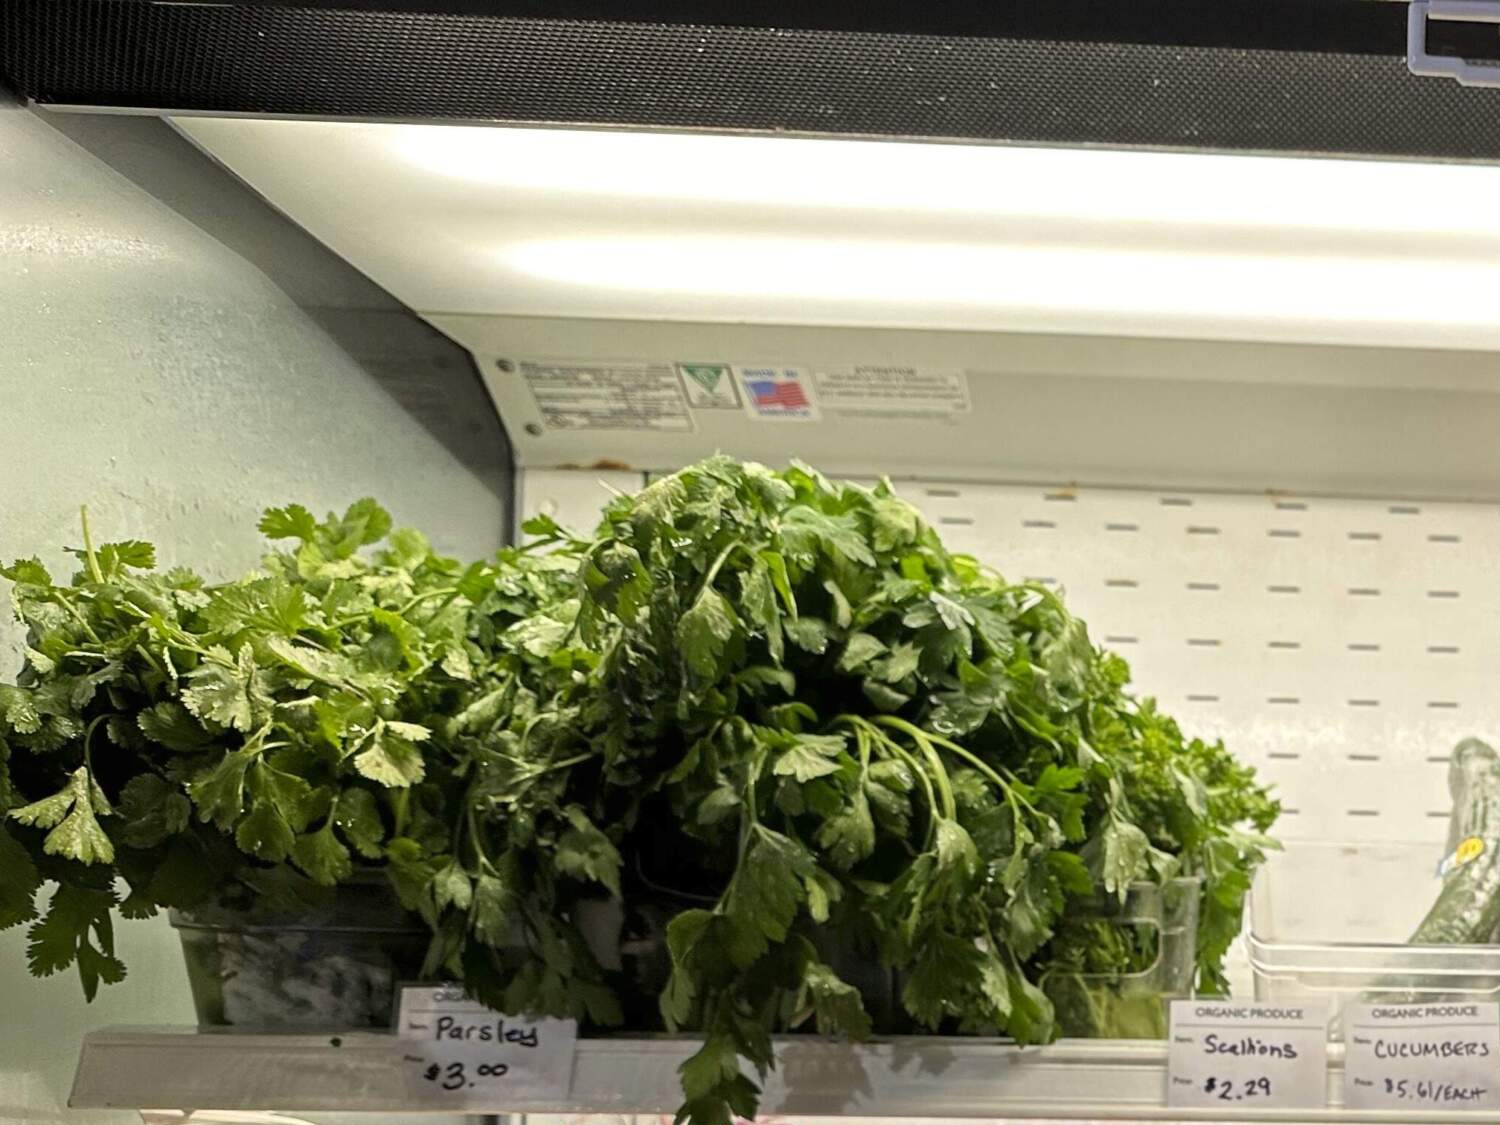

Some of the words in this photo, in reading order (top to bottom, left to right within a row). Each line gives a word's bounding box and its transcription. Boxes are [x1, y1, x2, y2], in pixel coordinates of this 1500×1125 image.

[1195, 1008, 1247, 1018] ORGANIC
[1250, 1009, 1304, 1020] PRODUCE
[1372, 1008, 1423, 1018] ORGANIC
[1425, 1006, 1478, 1017] PRODUCE
[436, 1016, 537, 1047] Parsley
[1204, 1034, 1297, 1058] Scallions
[1374, 1040, 1490, 1058] CUCUMBERS
[424, 1062, 508, 1090] $3.00
[1204, 1077, 1271, 1101] $2.29
